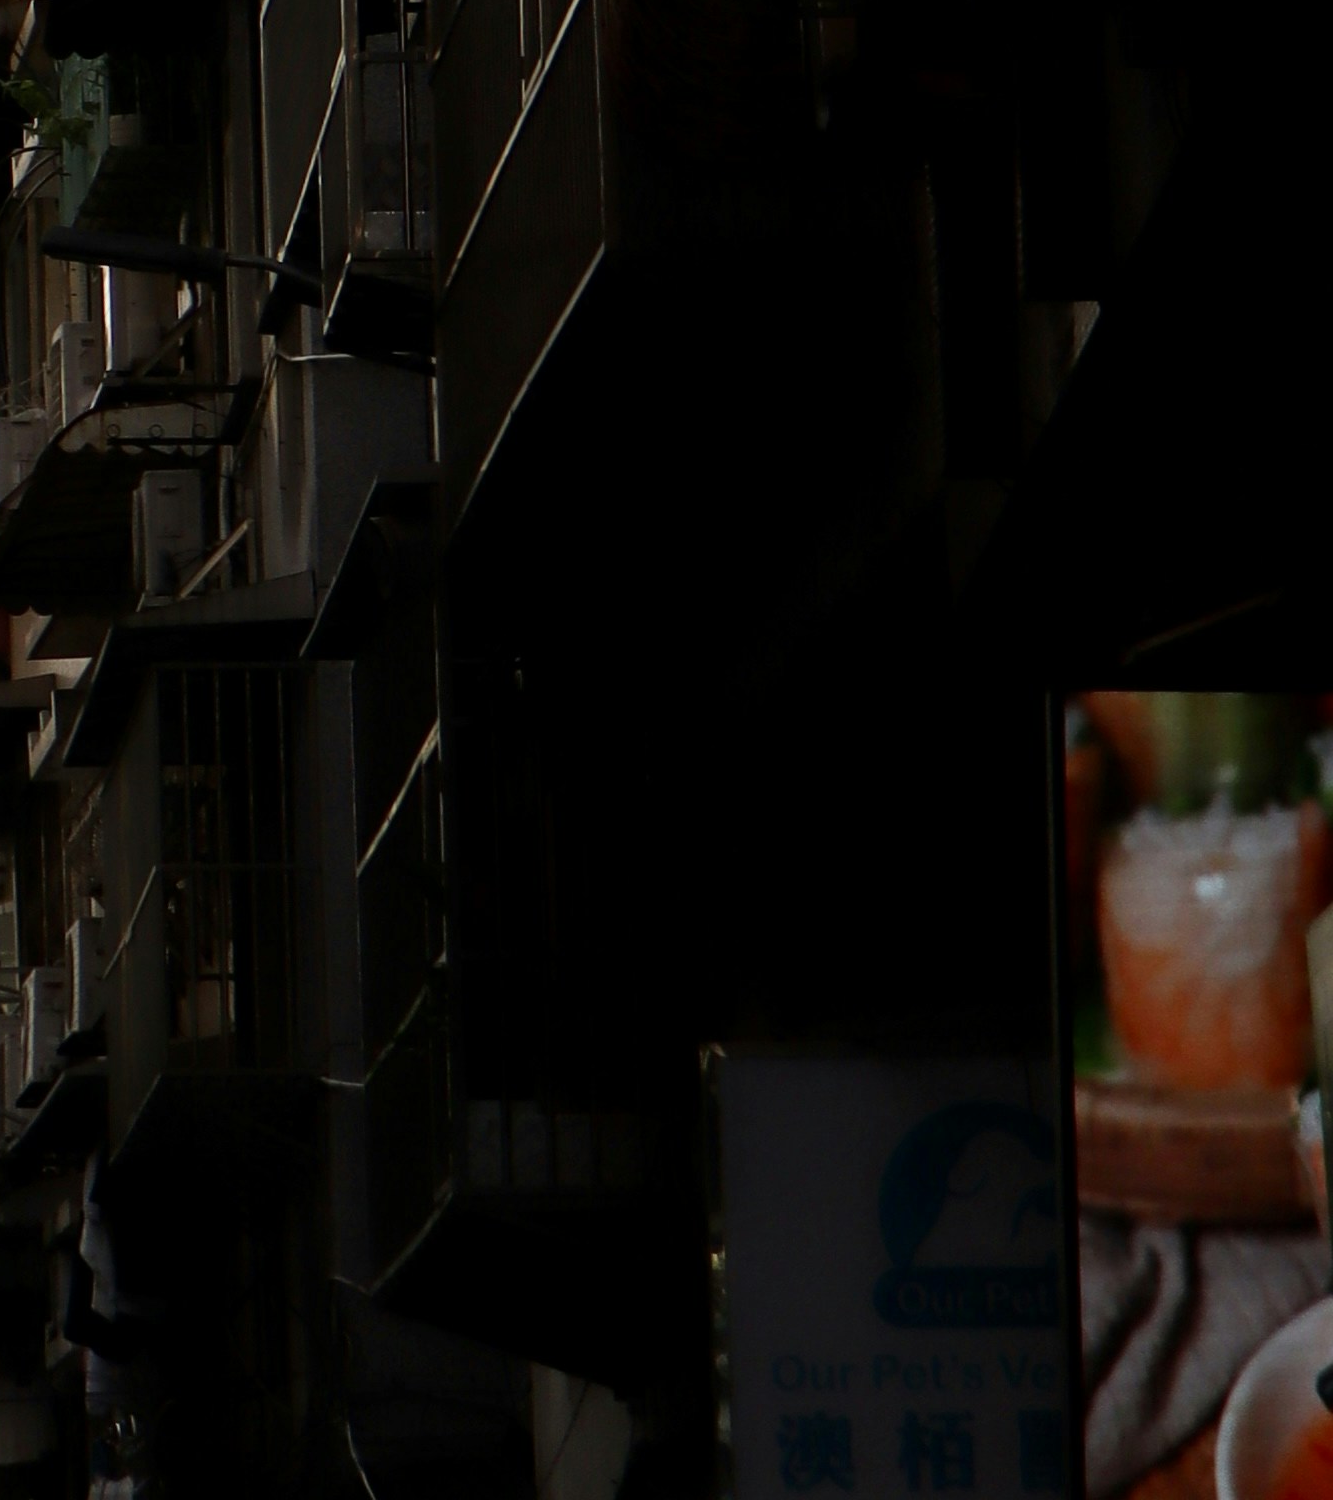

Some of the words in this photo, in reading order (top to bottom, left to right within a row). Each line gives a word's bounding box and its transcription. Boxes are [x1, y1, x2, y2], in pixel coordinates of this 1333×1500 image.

[898, 1282, 974, 1316] Our
[771, 1354, 853, 1392] Our
[871, 1354, 984, 1392] Pet's
